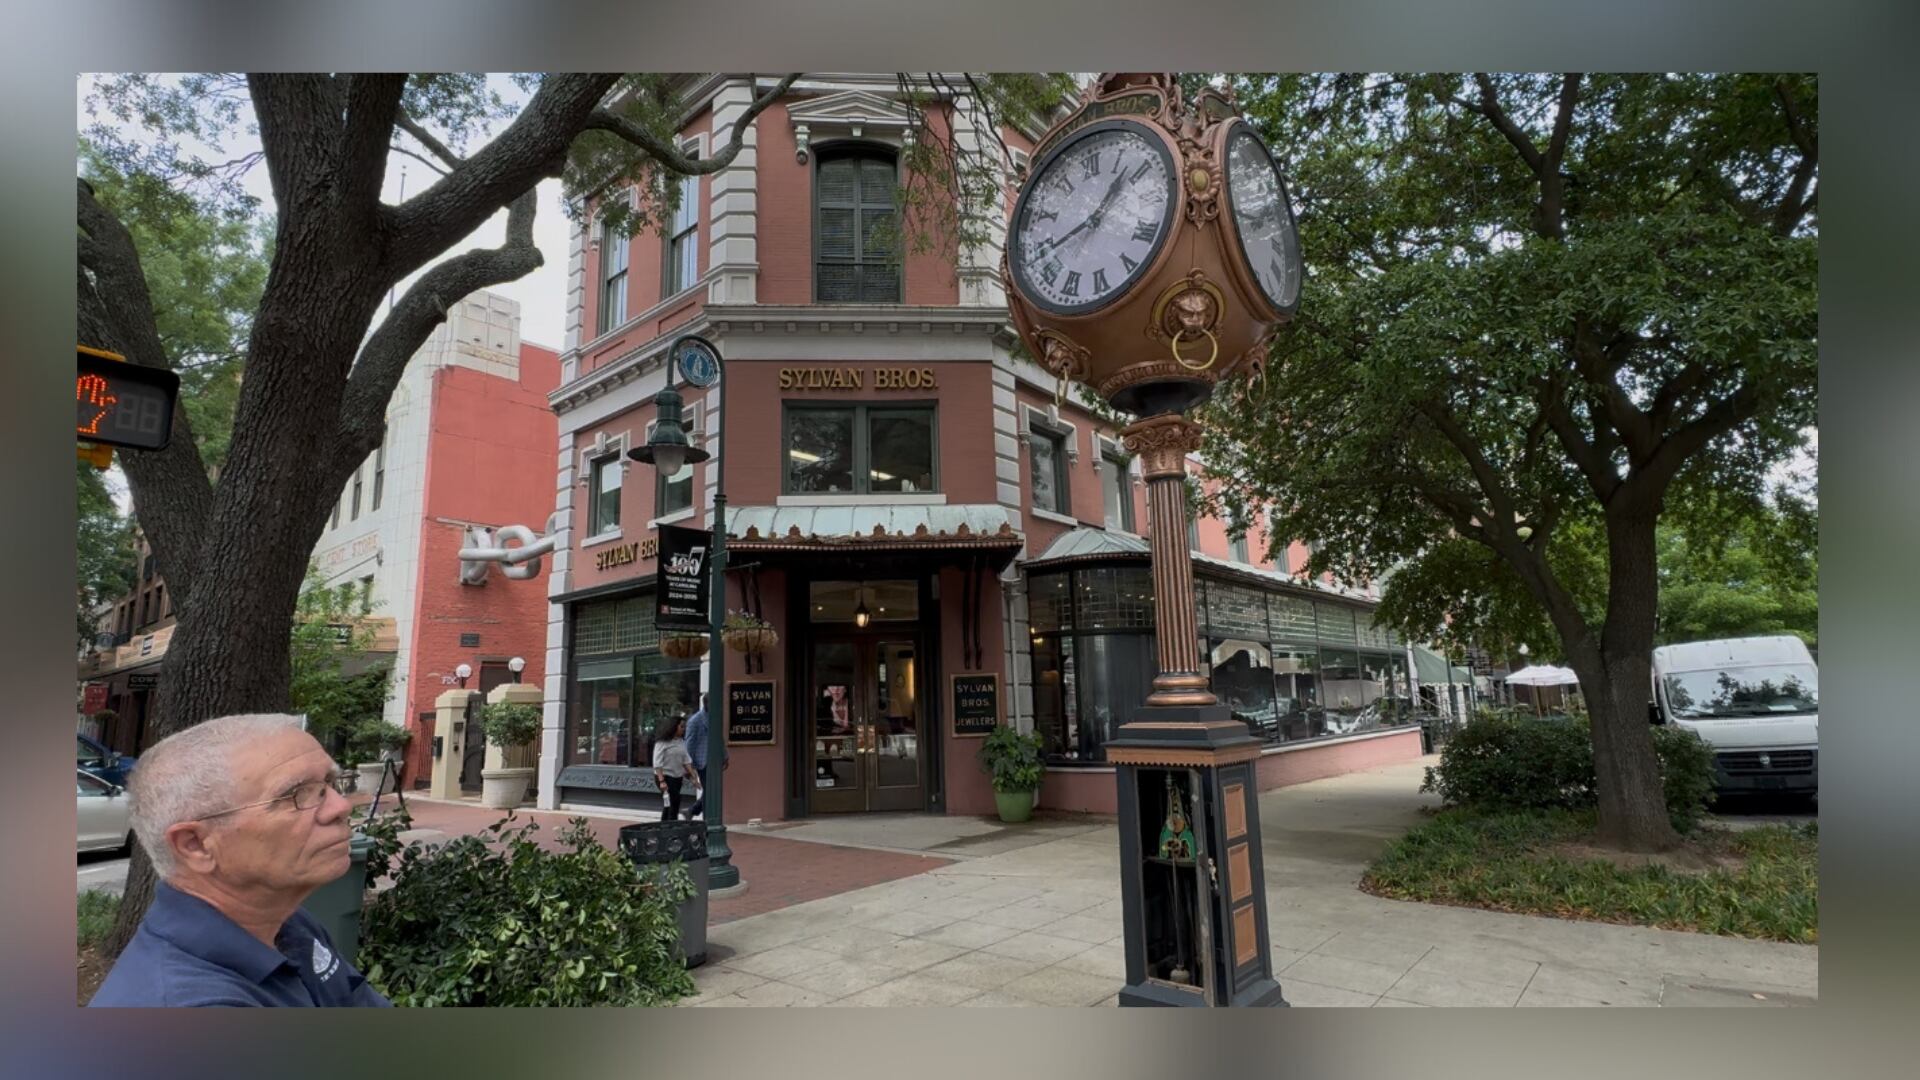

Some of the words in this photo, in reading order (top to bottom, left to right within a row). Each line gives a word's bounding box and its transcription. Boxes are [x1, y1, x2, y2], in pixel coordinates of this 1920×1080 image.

[779, 367, 864, 389] SYLVAN
[873, 367, 939, 389] BROS.
[595, 542, 638, 570] SYLVAN
[641, 537, 659, 560] BR
[956, 684, 995, 693] SYLVAN
[732, 691, 771, 700] SYLVAN
[956, 716, 996, 726] JEWELERS
[730, 724, 772, 734] JEWELERS
